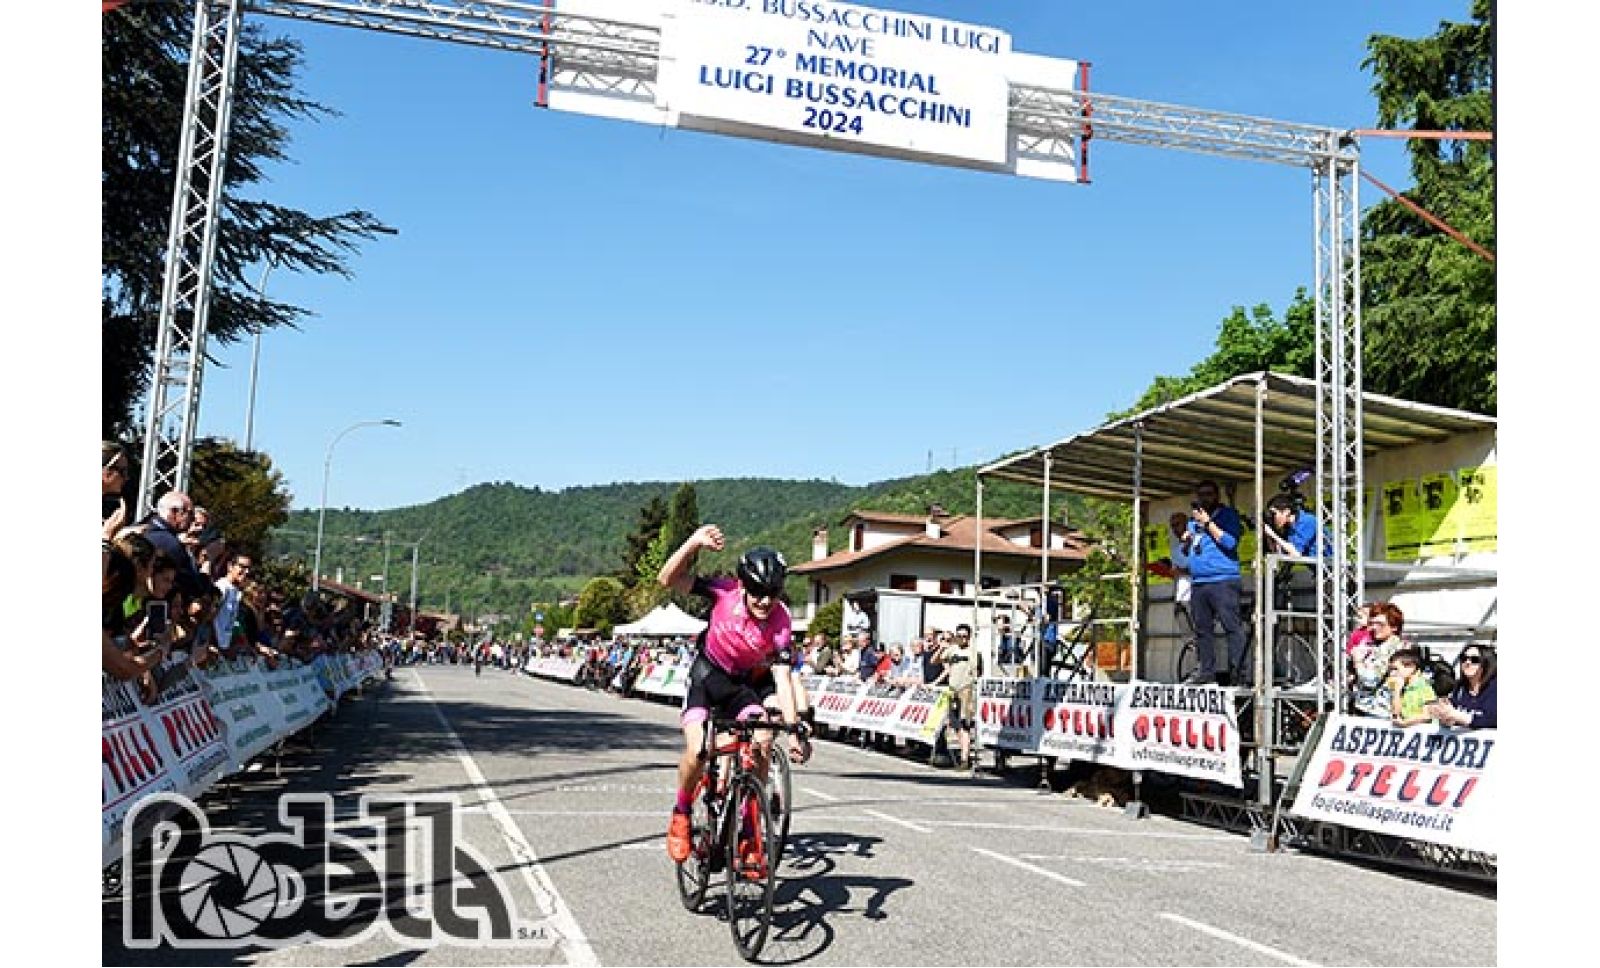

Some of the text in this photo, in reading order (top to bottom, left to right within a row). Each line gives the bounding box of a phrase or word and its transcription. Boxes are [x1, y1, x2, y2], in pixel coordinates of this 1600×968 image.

[762, 0, 1000, 54] BUSSACCHINI LUIGI
[807, 28, 876, 58] NAVE
[795, 52, 941, 96] MEMORIAL
[699, 64, 972, 128] LUIGI BUSSACCHINI
[802, 106, 864, 135] 2024
[1129, 685, 1227, 714] ASPIRATORI
[1043, 707, 1116, 739] OTELLI
[1133, 714, 1227, 752] OTELLI
[1330, 723, 1495, 770] ASPIRATORI
